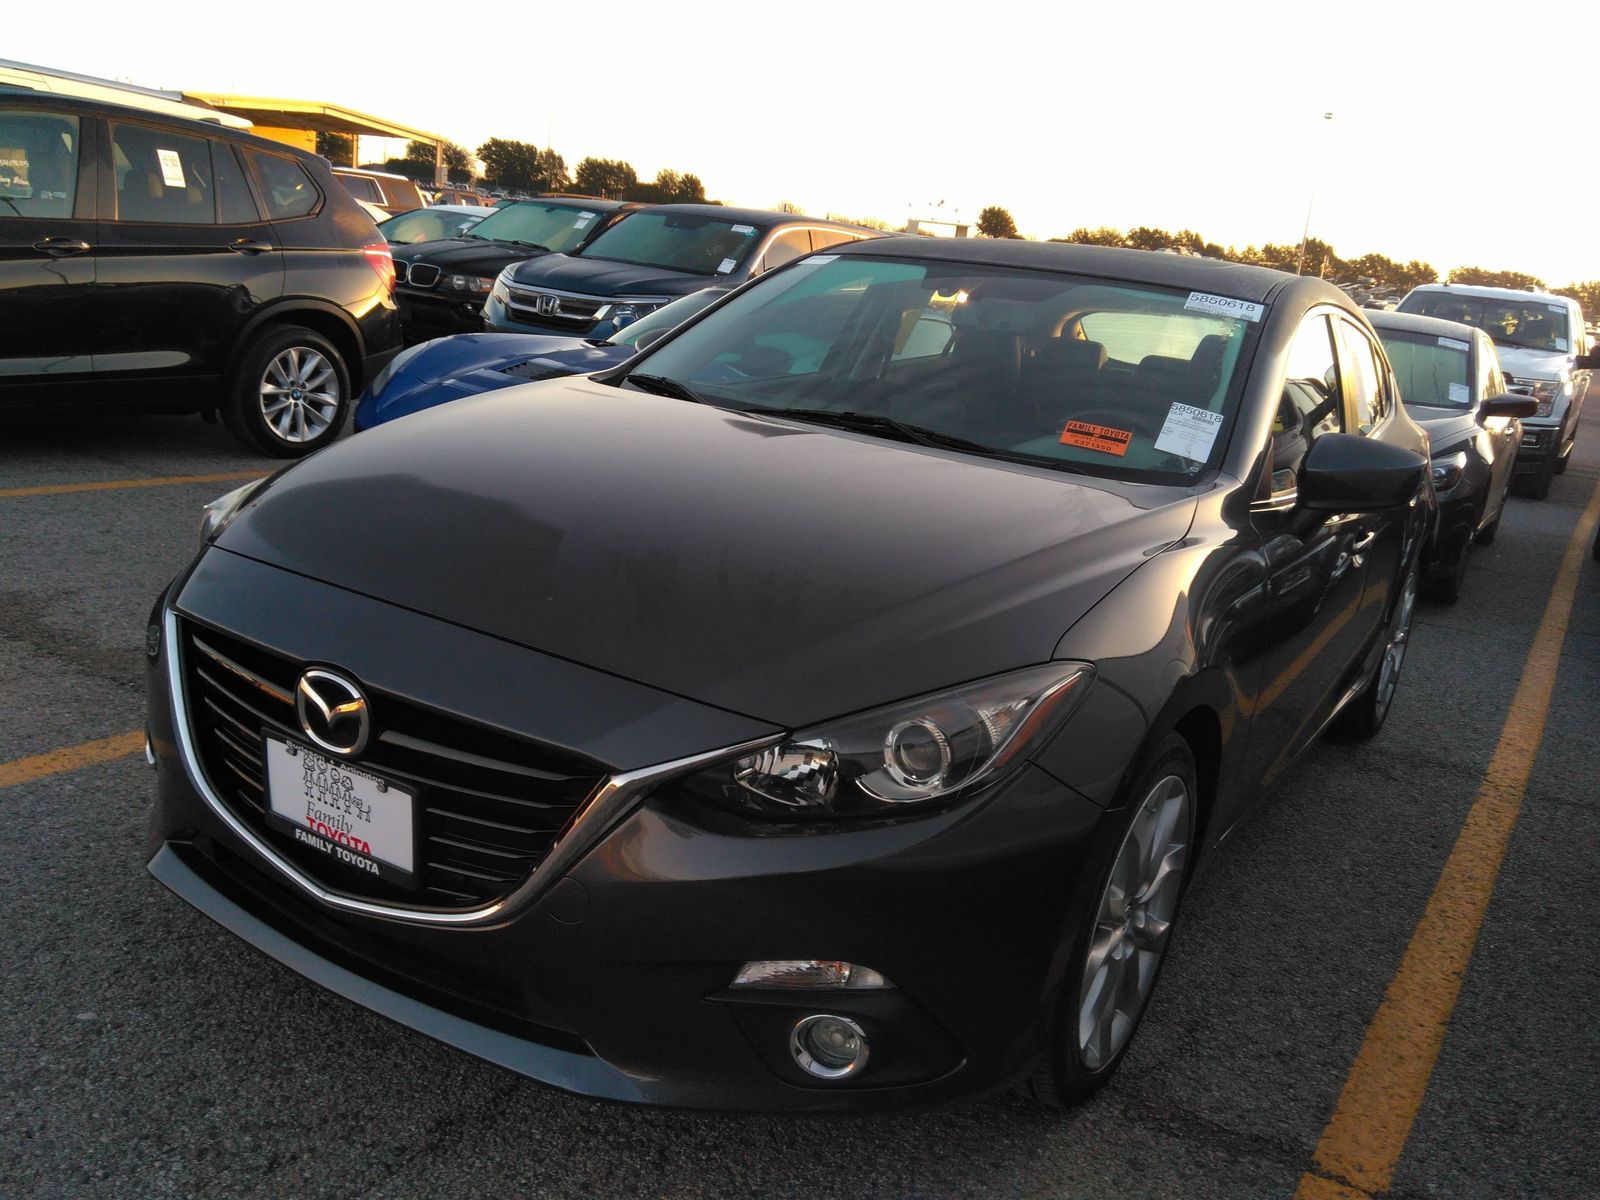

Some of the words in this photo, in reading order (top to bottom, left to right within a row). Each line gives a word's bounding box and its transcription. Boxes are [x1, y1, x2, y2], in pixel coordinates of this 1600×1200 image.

[1190, 294, 1256, 312] 5850618
[1171, 403, 1222, 423] 5850618
[1067, 422, 1097, 433] FAMILY
[1100, 428, 1130, 440] TOYOTA
[340, 764, 385, 784] Arlington
[306, 800, 353, 837] Family
[306, 816, 372, 856] TOYOTA
[295, 828, 334, 854] FAMILY
[335, 846, 380, 875] TOYOTA
